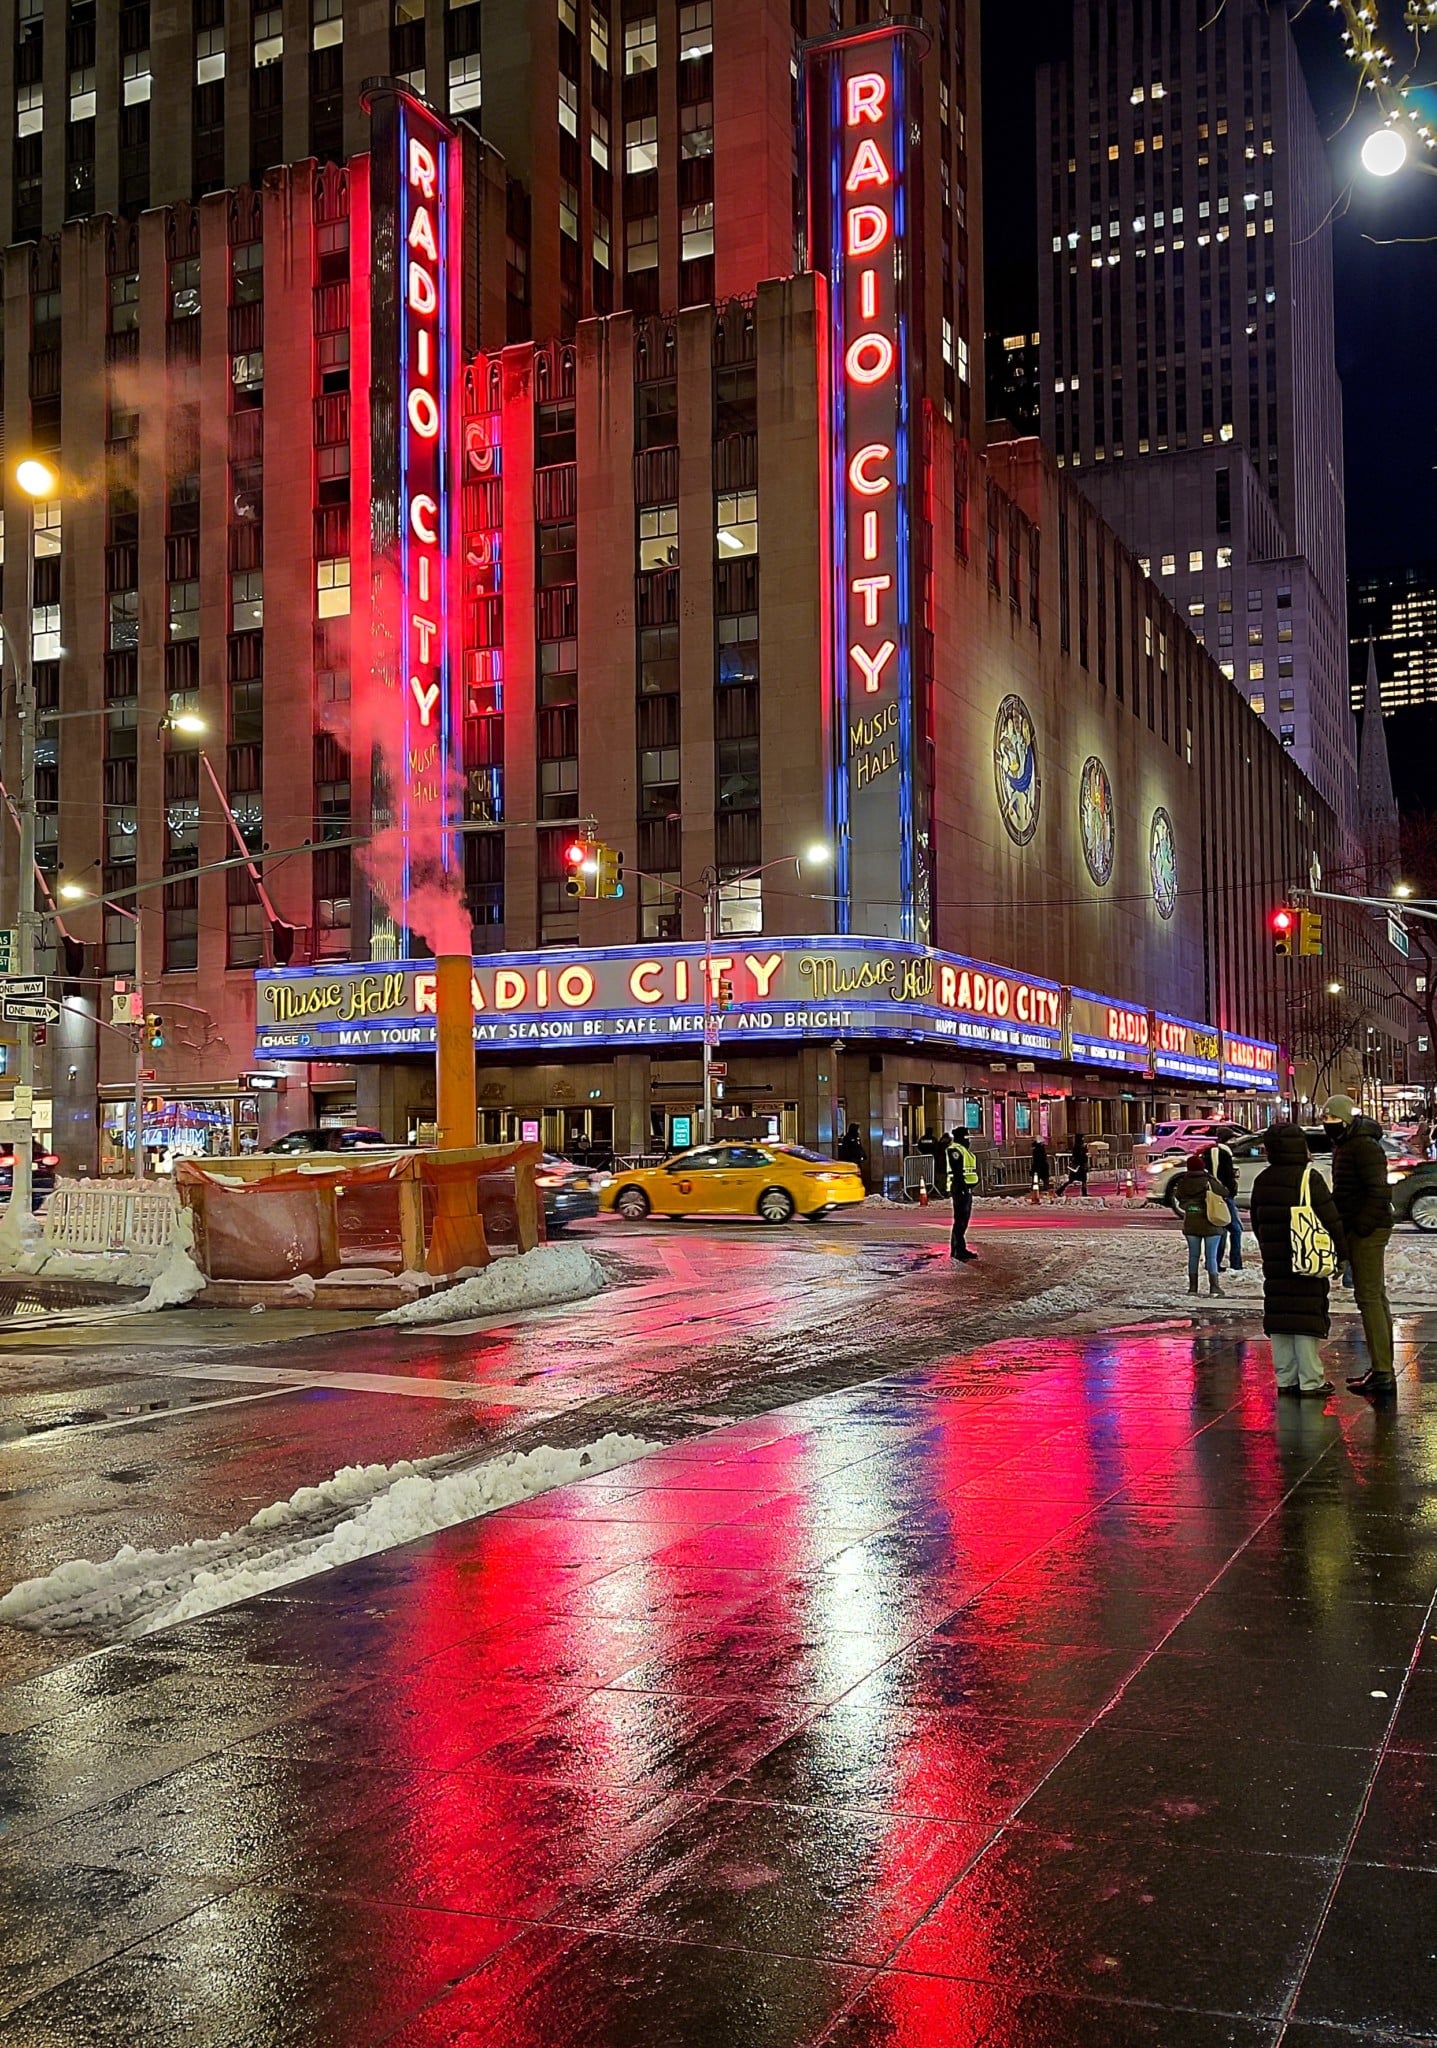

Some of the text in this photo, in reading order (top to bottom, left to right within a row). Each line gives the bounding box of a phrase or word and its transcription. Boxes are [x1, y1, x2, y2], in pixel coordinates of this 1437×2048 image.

[845, 71, 896, 693] RADIO CITY
[407, 137, 440, 728] RADIO CITY
[850, 702, 898, 757] MUSIC
[857, 743, 898, 789] HALL
[23, 982, 41, 992] WAY
[264, 972, 408, 1022] Music Hall
[628, 953, 783, 1004] CITY
[799, 956, 935, 1001] Music Hall
[940, 965, 1059, 1026] RADIO CITY
[8, 1005, 53, 1018] ONE WAY
[339, 1030, 371, 1045] MAY
[381, 1027, 421, 1043] YOUR
[508, 1021, 574, 1038] SEASON
[583, 1019, 603, 1035] BE
[669, 1014, 726, 1032] MERY
[738, 1012, 773, 1029] AND
[784, 1011, 852, 1028] BRIGHT
[935, 1018, 957, 1035] HAPPY
[958, 1022, 990, 1041] HOLIDAYS
[1107, 1008, 1149, 1046] RADIO
[261, 1035, 299, 1047] CHASE
[1160, 1021, 1187, 1053] CITY
